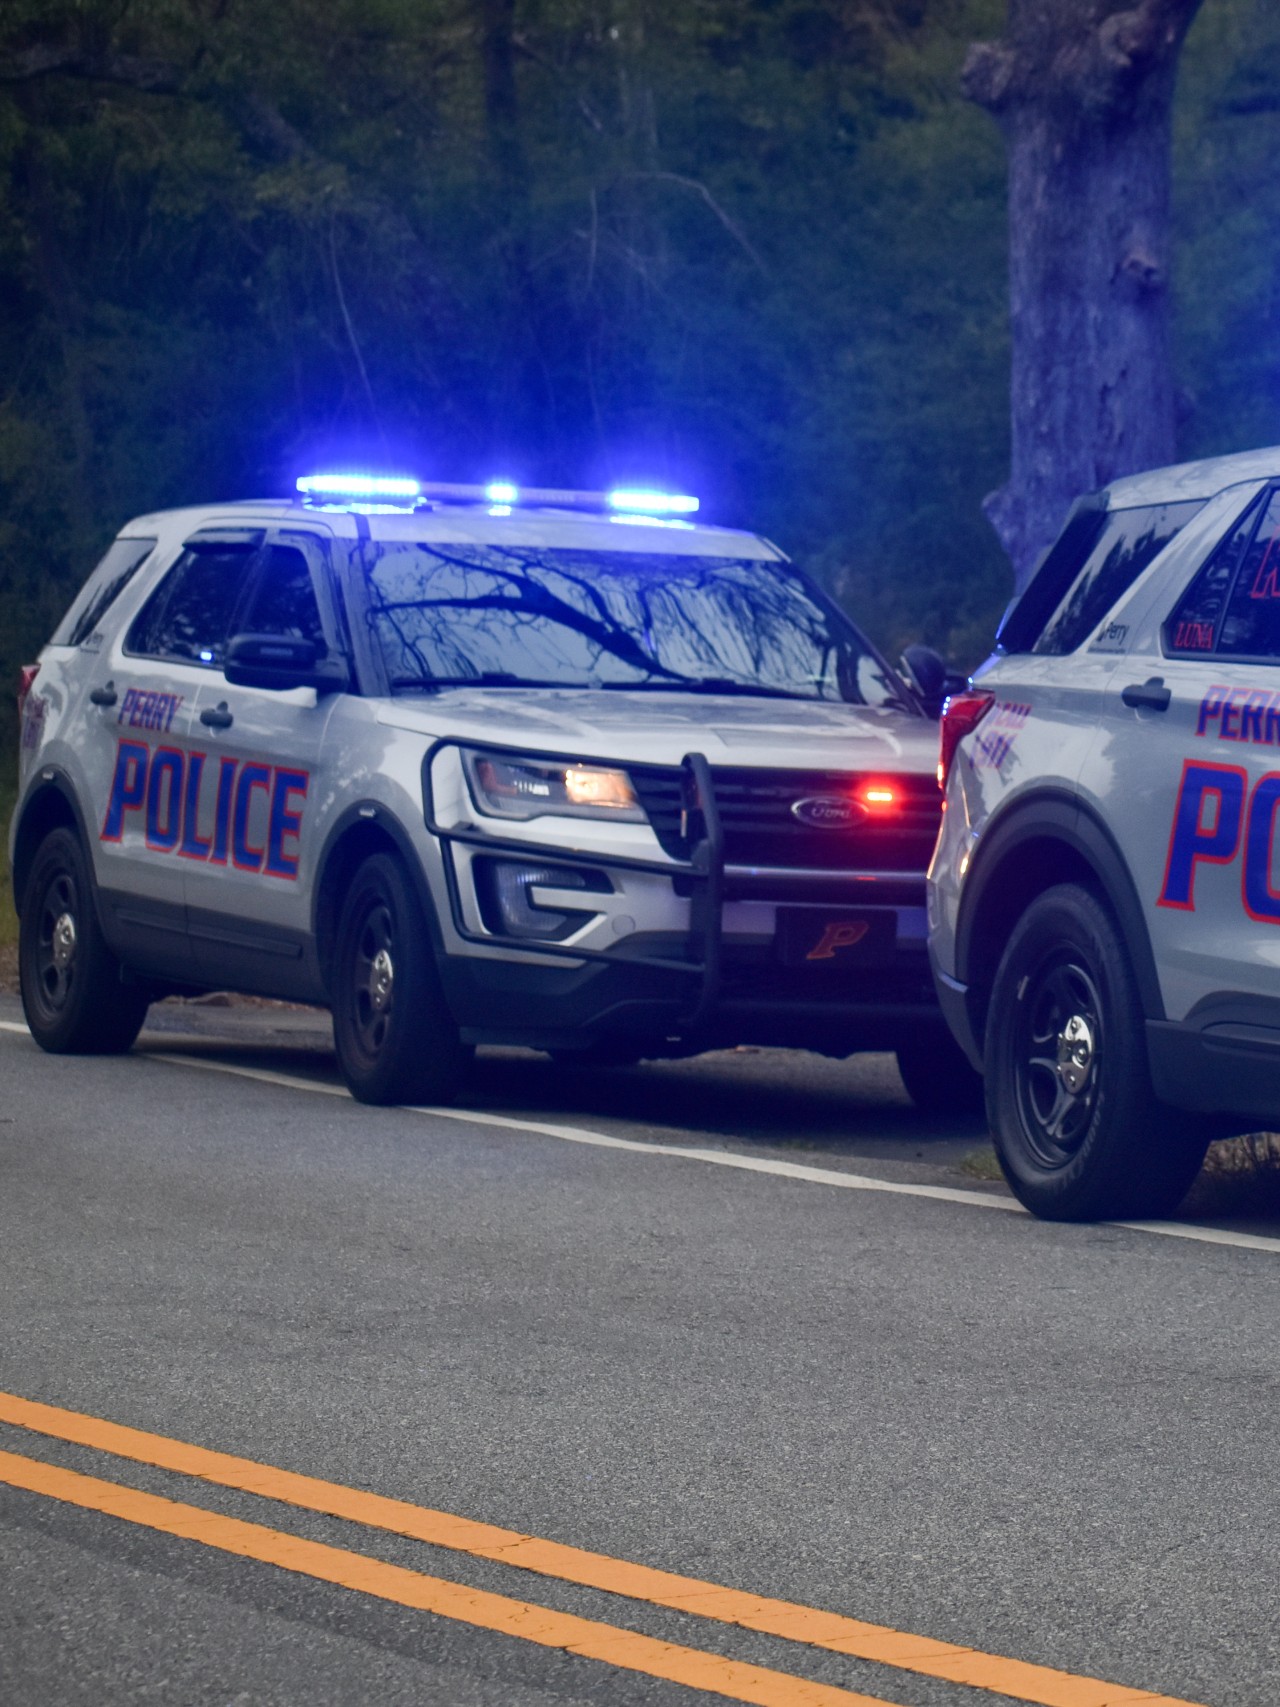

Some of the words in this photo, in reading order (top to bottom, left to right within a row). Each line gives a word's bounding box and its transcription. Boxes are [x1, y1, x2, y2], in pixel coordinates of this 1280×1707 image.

[1174, 622, 1214, 649] LUNA
[118, 688, 185, 733] PERRY
[99, 736, 310, 882] POLICE
